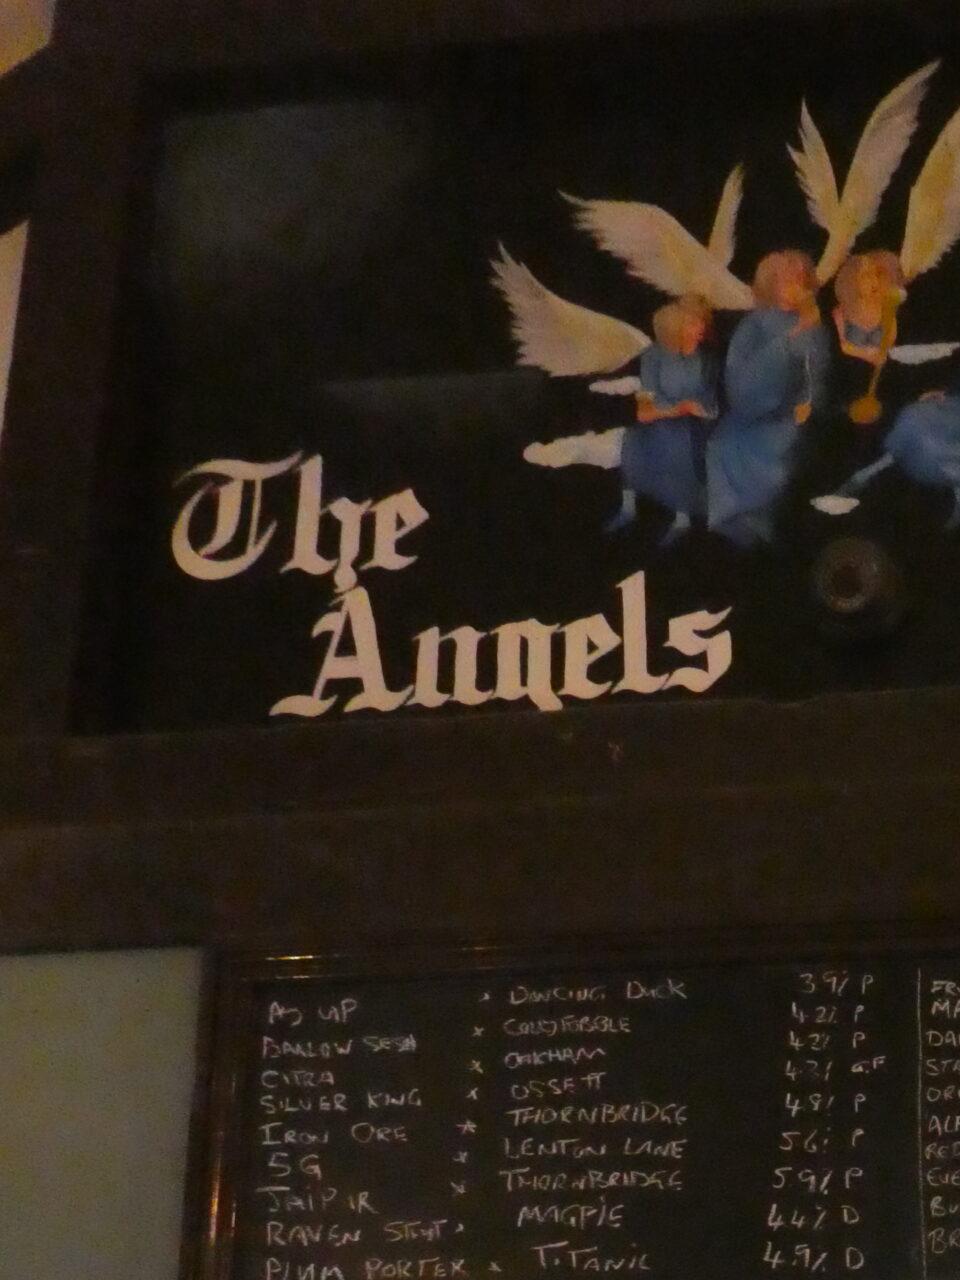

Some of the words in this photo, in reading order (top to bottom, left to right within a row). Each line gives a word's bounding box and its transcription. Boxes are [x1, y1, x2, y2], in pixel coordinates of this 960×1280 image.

[172, 450, 430, 591] The
[269, 569, 733, 717] Angels
[260, 1070, 335, 1089] CITRA
[260, 1093, 348, 1115] SILVER
[368, 1088, 422, 1109] KING
[506, 1101, 688, 1127] THORNBRIDGE
[854, 1093, 867, 1113] P
[624, 1138, 688, 1159] LANE
[845, 1168, 863, 1189] P
[841, 1204, 860, 1225] D
[845, 1247, 865, 1271] D
